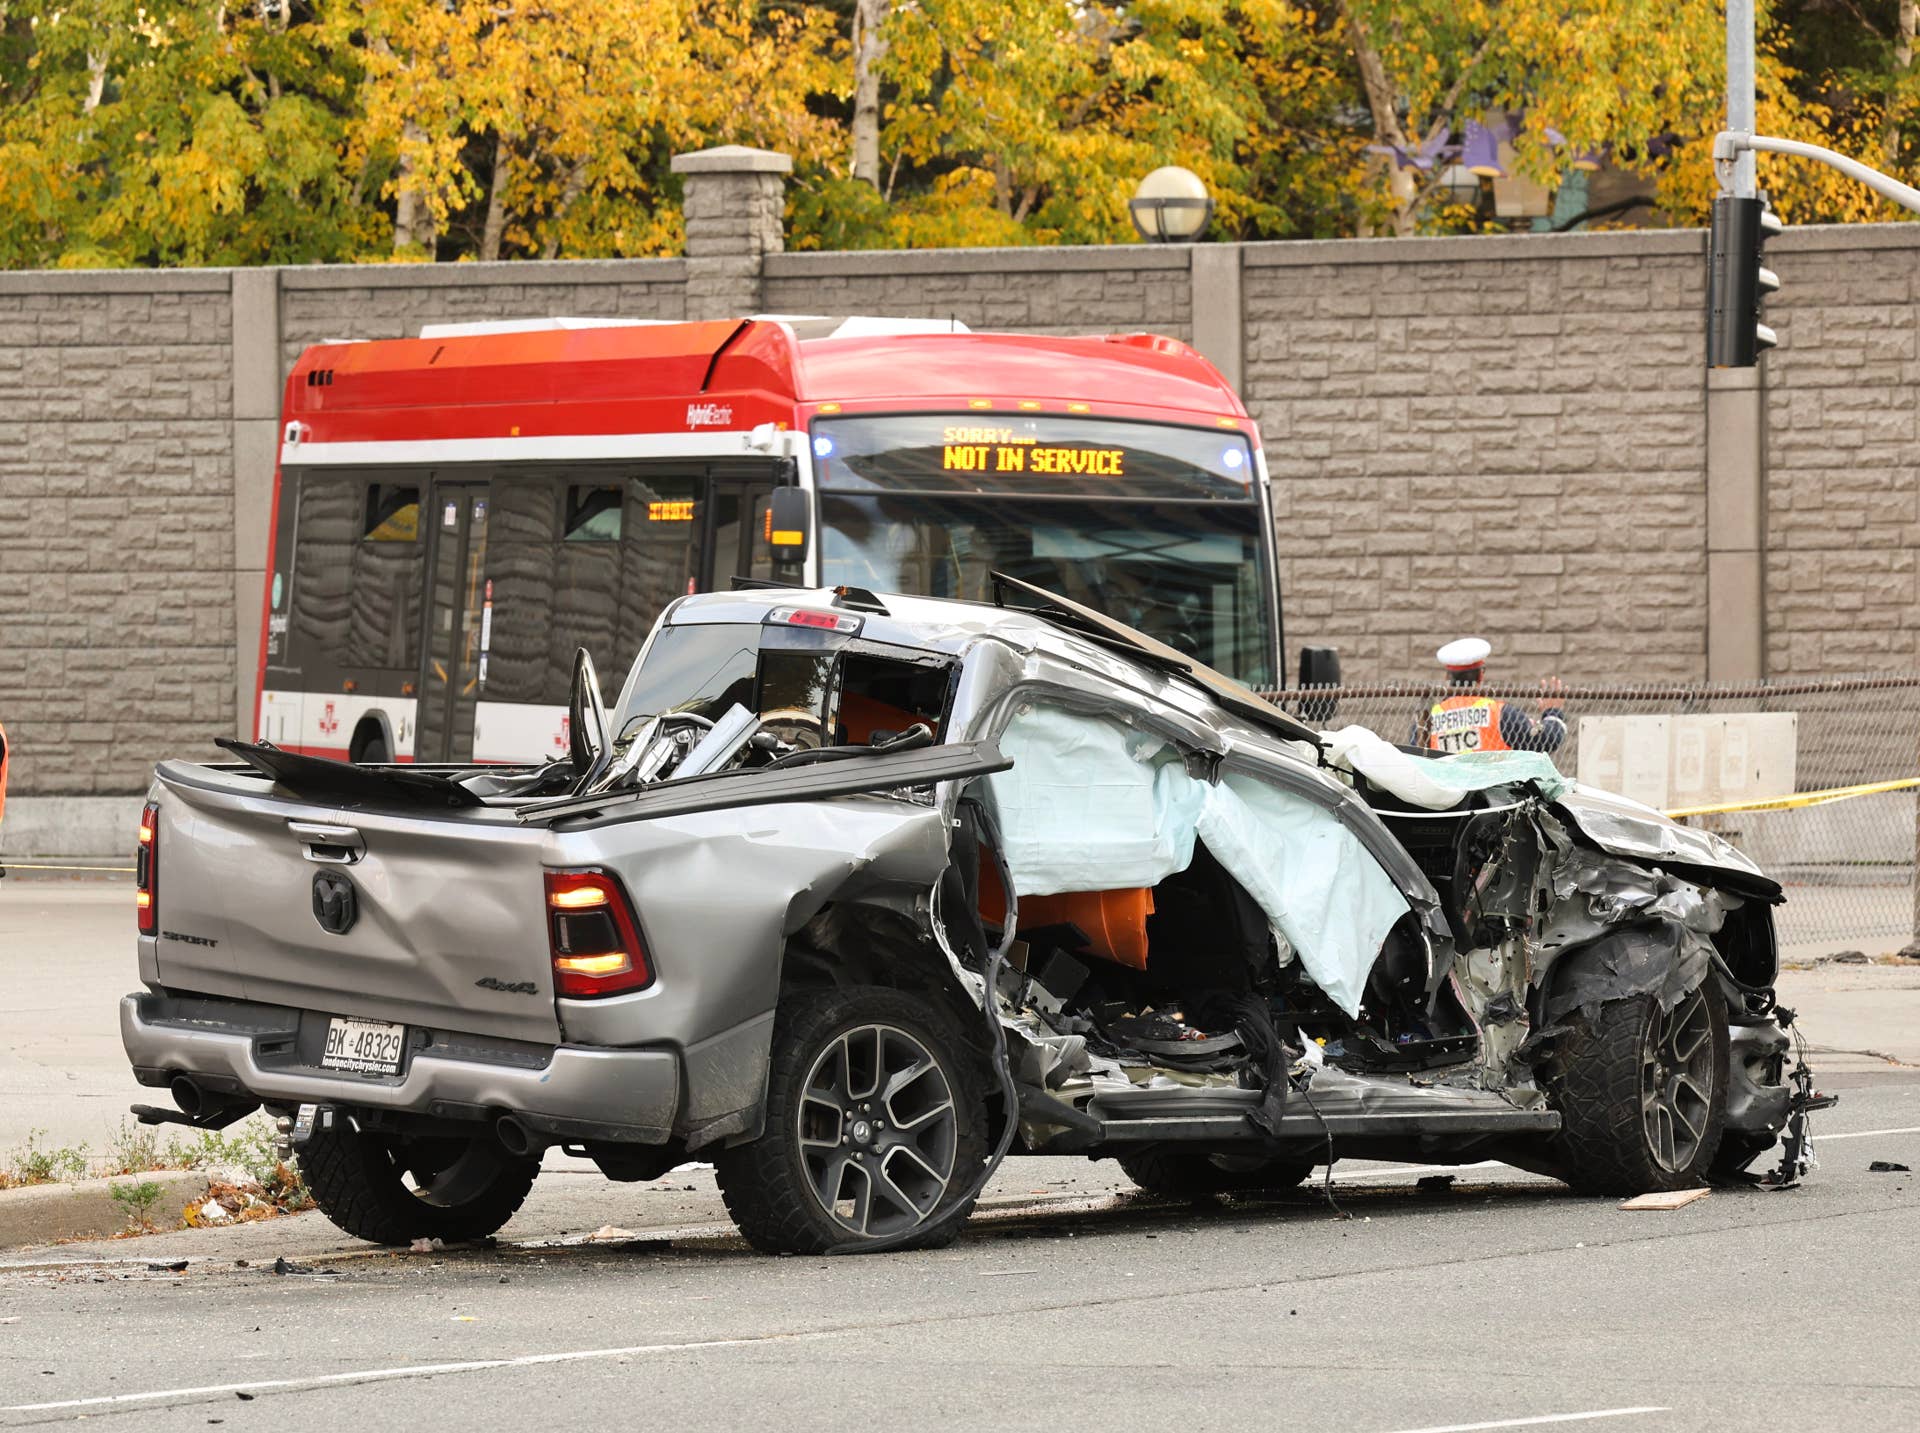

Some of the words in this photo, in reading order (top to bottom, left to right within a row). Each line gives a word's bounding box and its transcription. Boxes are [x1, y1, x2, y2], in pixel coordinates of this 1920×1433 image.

[943, 446, 990, 470] NOT
[996, 448, 1024, 471] IN
[1030, 449, 1124, 475] SERVICE
[1438, 730, 1479, 752] TTC
[162, 930, 218, 948] SPORT
[326, 1027, 348, 1056] BK
[354, 1031, 401, 1061] 48329
[322, 1055, 397, 1074] londoncitychrysler.com
